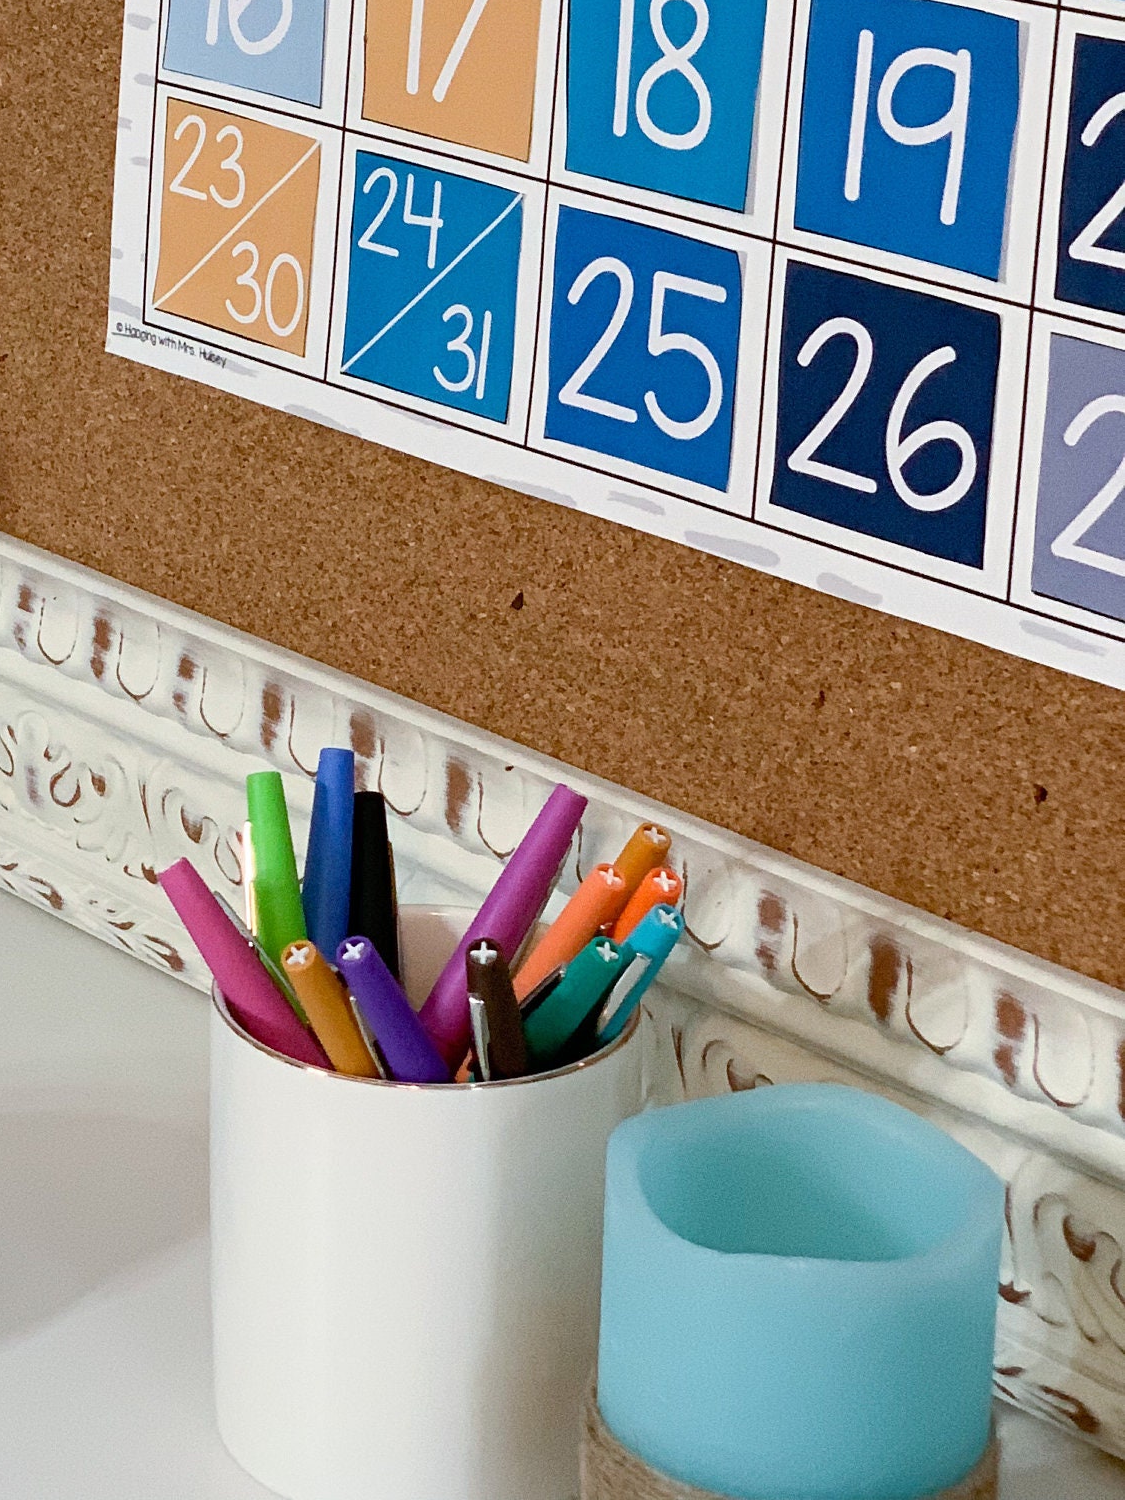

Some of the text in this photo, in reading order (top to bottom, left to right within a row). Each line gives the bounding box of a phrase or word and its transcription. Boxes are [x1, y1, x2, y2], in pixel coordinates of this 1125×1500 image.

[168, 114, 444, 269] 23 24
[843, 28, 972, 226] 19
[1068, 91, 1125, 270] 2
[124, 323, 157, 346] Hanging
[158, 336, 177, 350] with
[178, 340, 196, 357] Mrs.
[225, 240, 492, 400] 30 31
[557, 256, 1125, 577] 25 26 2
